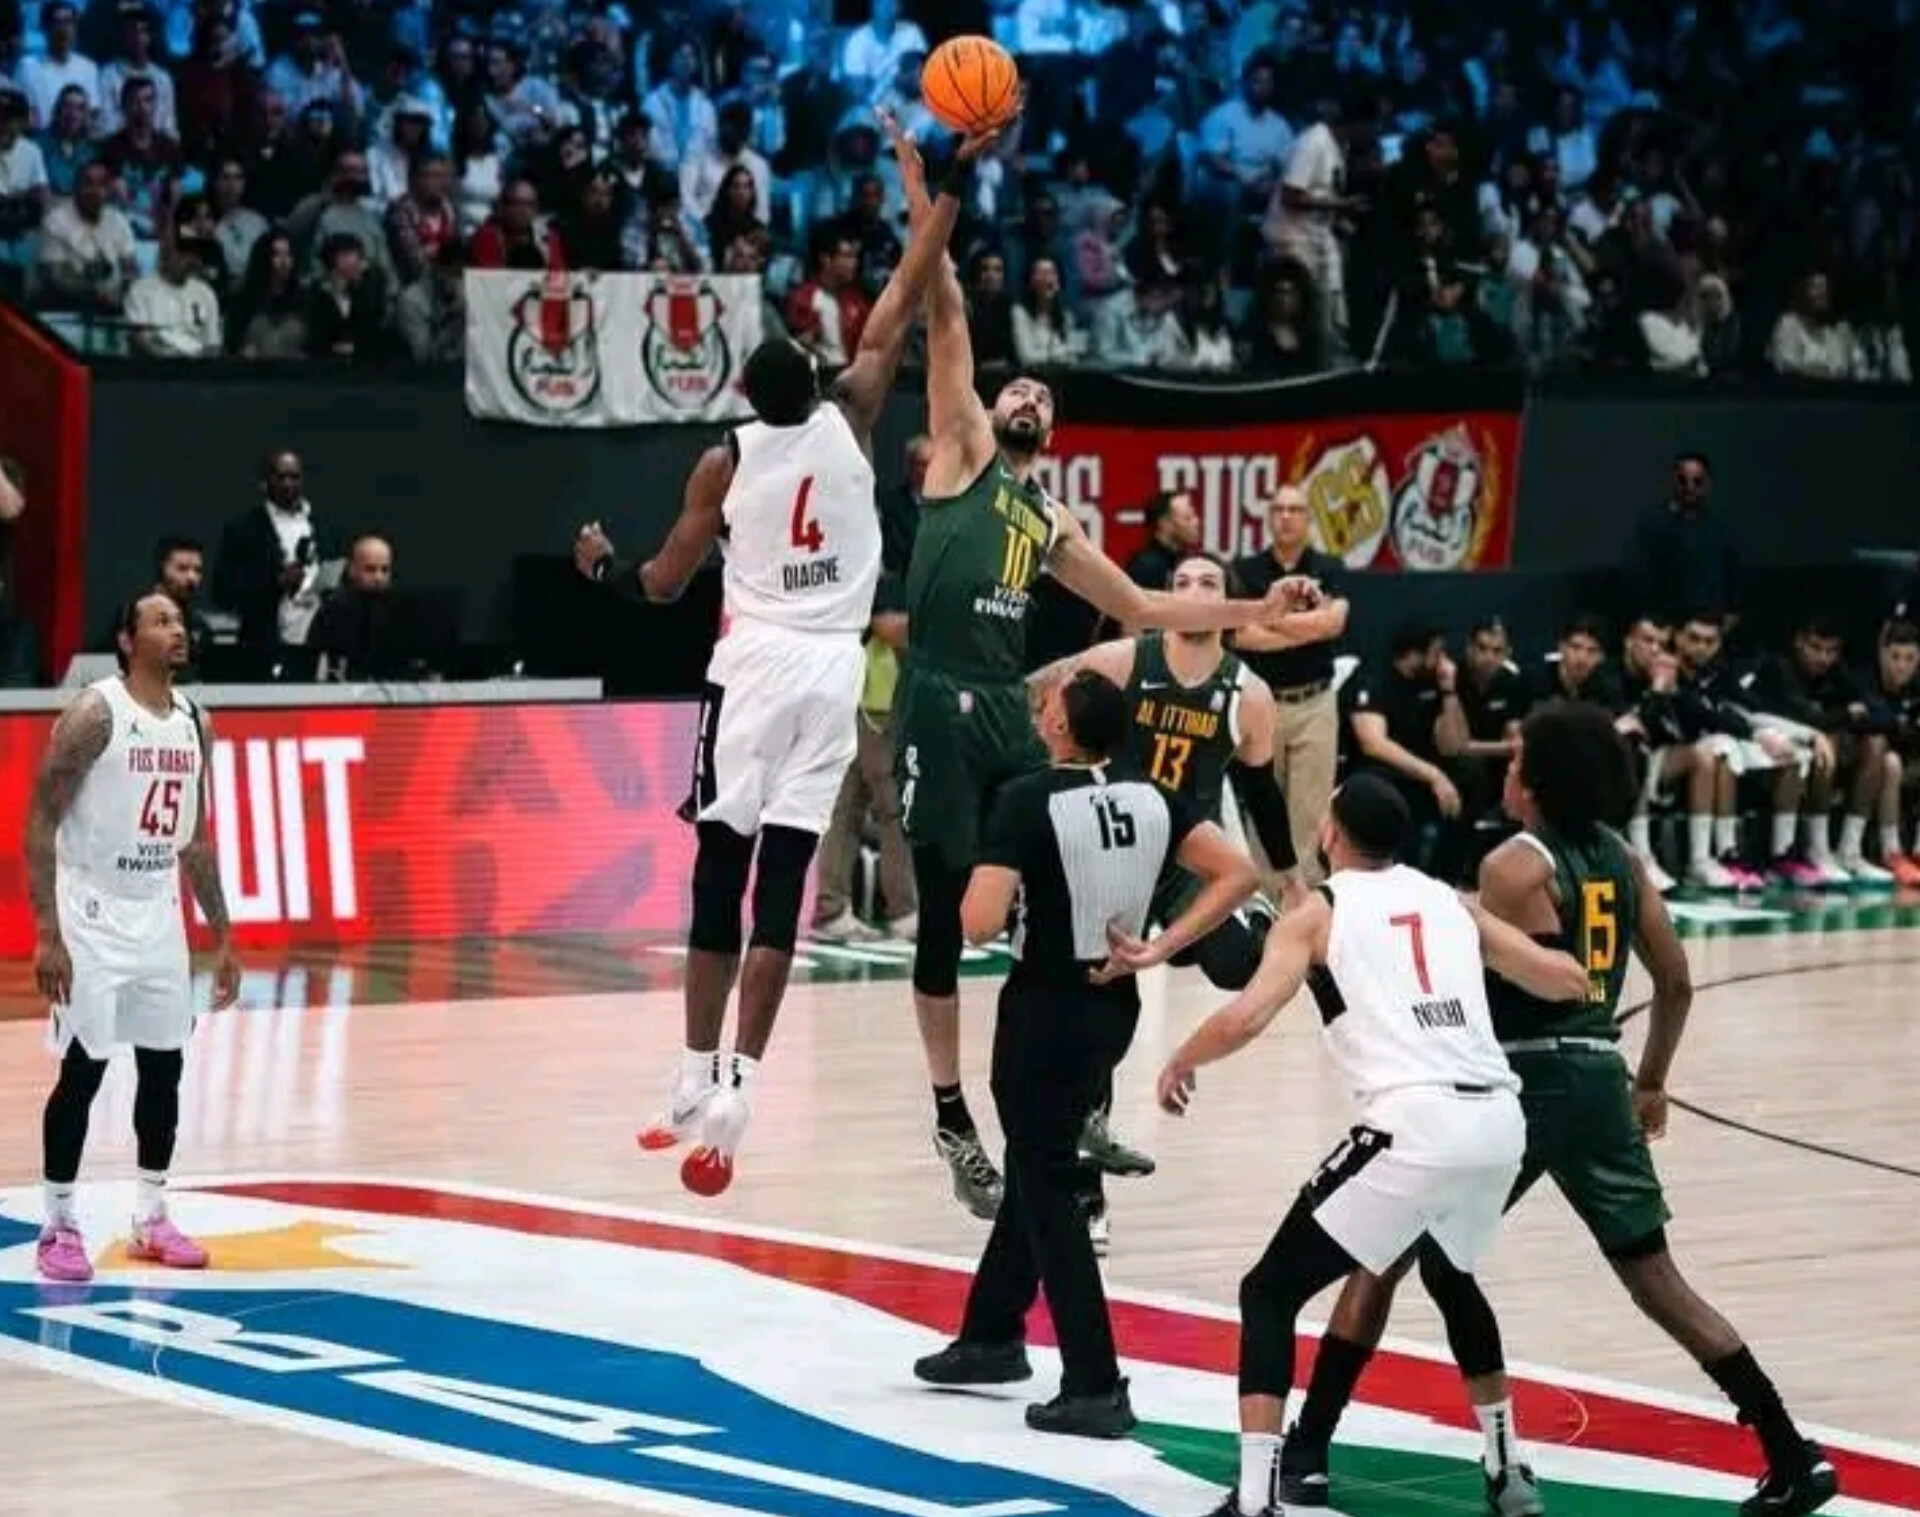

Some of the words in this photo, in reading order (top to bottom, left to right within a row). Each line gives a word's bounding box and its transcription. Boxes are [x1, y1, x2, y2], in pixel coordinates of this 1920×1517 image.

[791, 476, 825, 554] 4
[783, 557, 840, 592] DIAGNE
[1002, 525, 1032, 591] 10
[128, 747, 154, 773] FUS
[1151, 733, 1192, 792] 13
[140, 780, 182, 836] 45
[1089, 793, 1136, 850] 15
[1389, 912, 1433, 995] 7
